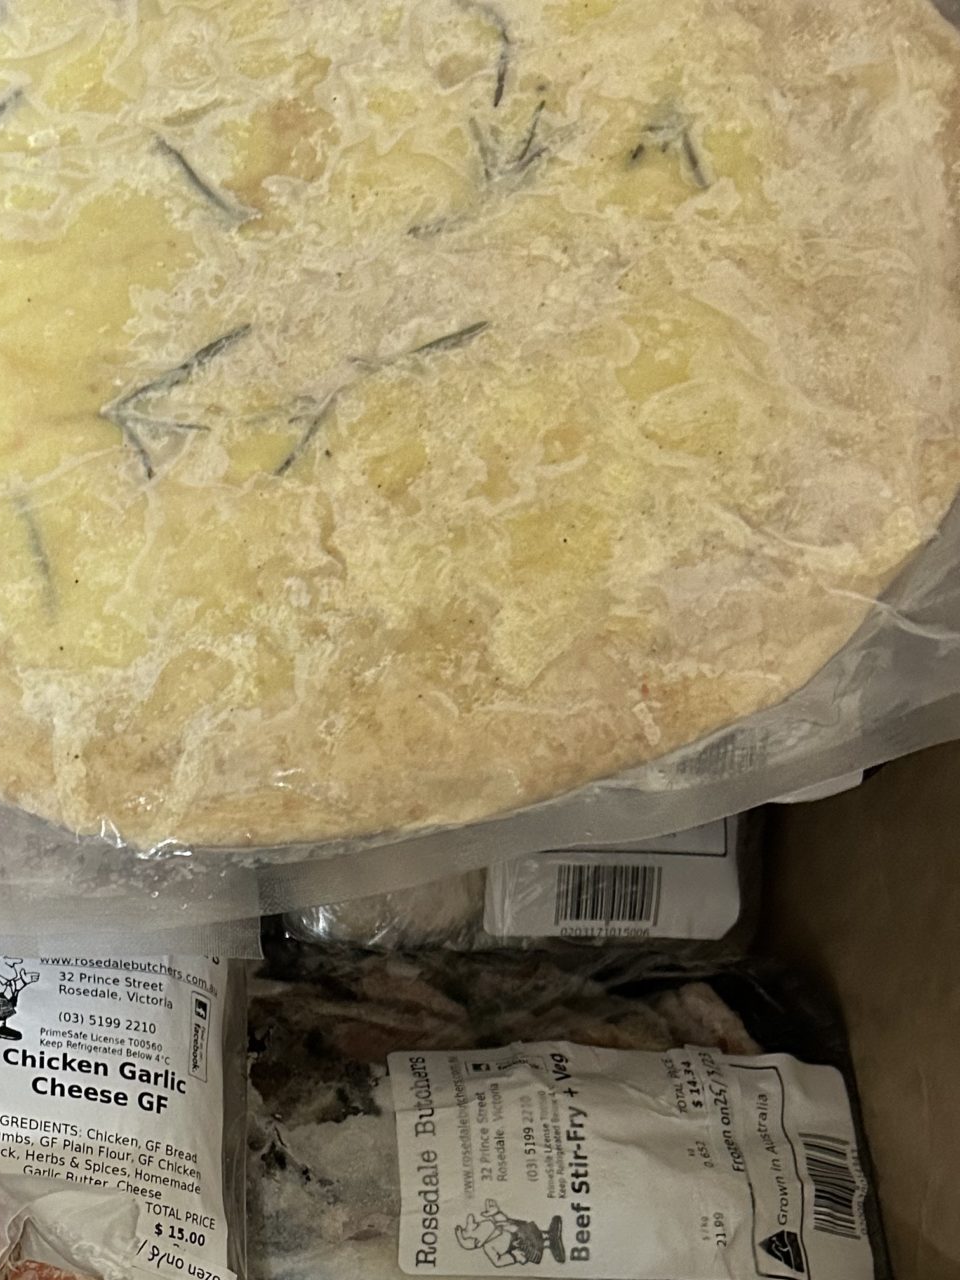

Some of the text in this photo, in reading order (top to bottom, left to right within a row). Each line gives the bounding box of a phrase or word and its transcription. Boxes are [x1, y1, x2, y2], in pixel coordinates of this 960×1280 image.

[59, 972, 163, 992] 32 Prince Street
[59, 985, 173, 1010] Rosedale, Victoria
[58, 1012, 156, 1034] (03) 5199 2210
[3, 1048, 186, 1094] Chicken Garlic
[552, 1053, 571, 1081] Veg
[32, 1077, 168, 1114] Cheese GF
[40, 1136, 57, 1148] GF
[62, 1138, 93, 1155] Plain
[98, 1146, 134, 1162] Flour,
[138, 1154, 153, 1166] GF
[158, 1159, 201, 1180] Chicken
[87, 1128, 141, 1149] Chicken,
[145, 1140, 161, 1152] GF
[166, 1144, 198, 1163] Bread
[410, 1057, 438, 1267] Rosedale Butchers
[567, 1106, 589, 1194] Stir-Fry
[723, 1129, 745, 1172] Frozen
[756, 1094, 788, 1225] Grown in Australia
[26, 1150, 65, 1166] Herbs
[70, 1156, 79, 1169] &
[85, 1159, 130, 1178] Spices,
[134, 1168, 201, 1195] Homemade
[145, 1202, 216, 1230] TOTAL PRICE
[154, 1223, 205, 1246] $ 15.00
[570, 1203, 590, 1261] Beef
[166, 1253, 184, 1269] on
